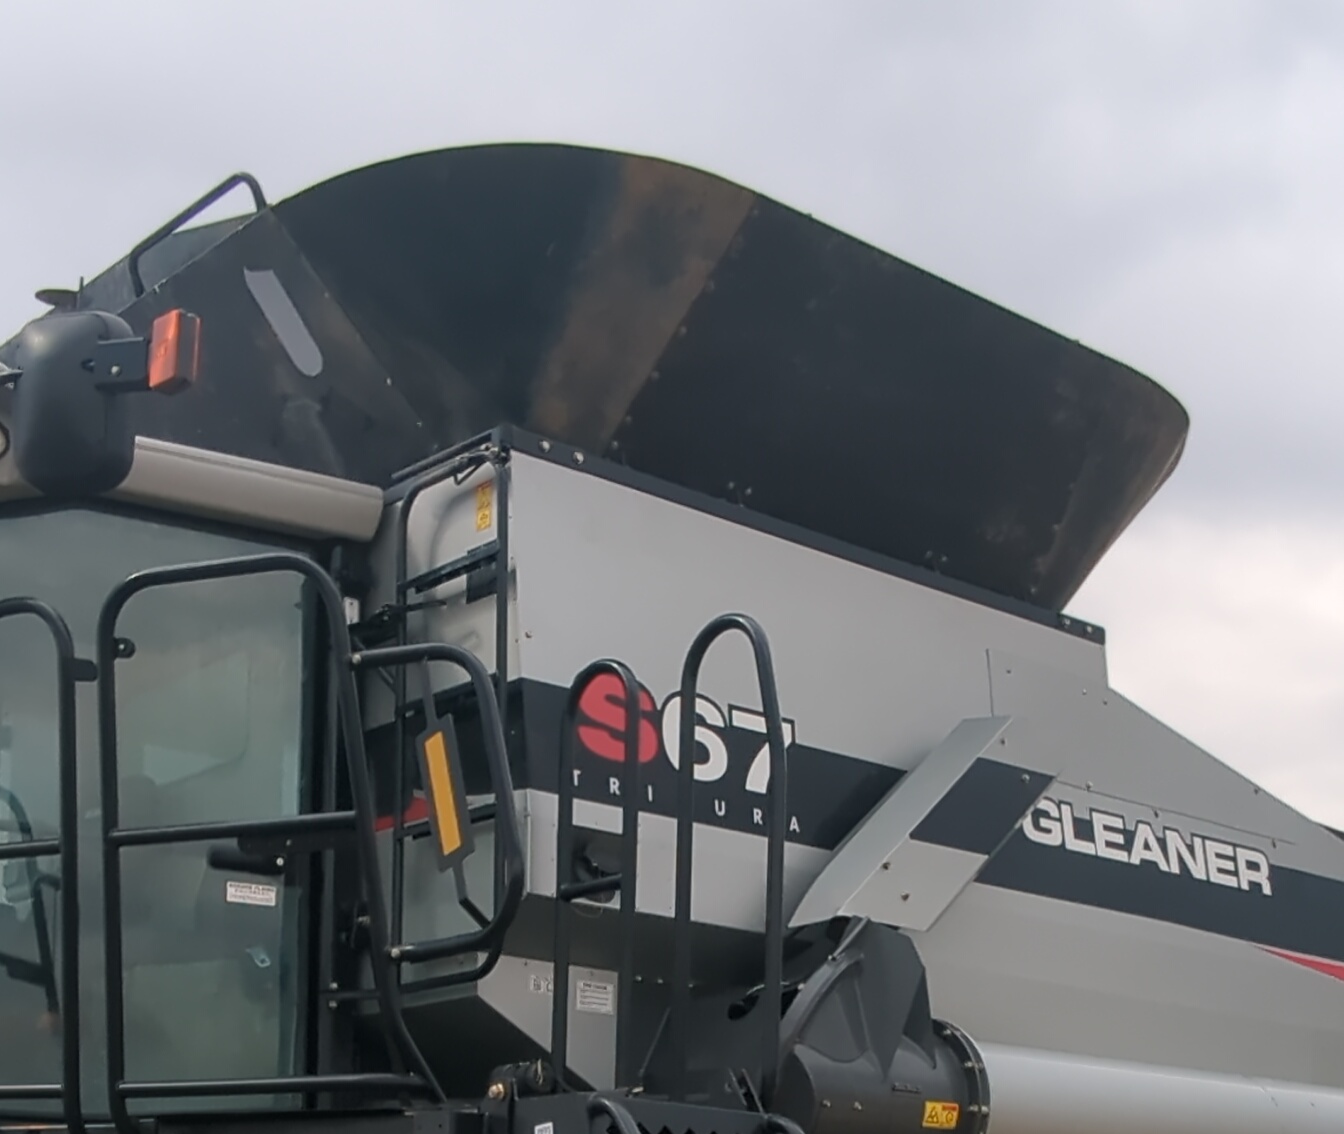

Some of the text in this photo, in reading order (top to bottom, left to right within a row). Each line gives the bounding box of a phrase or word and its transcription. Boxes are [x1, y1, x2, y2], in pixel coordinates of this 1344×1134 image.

[576, 671, 794, 796] S67
[572, 769, 800, 833] TRIURA
[1022, 797, 1273, 896] GLEANER
